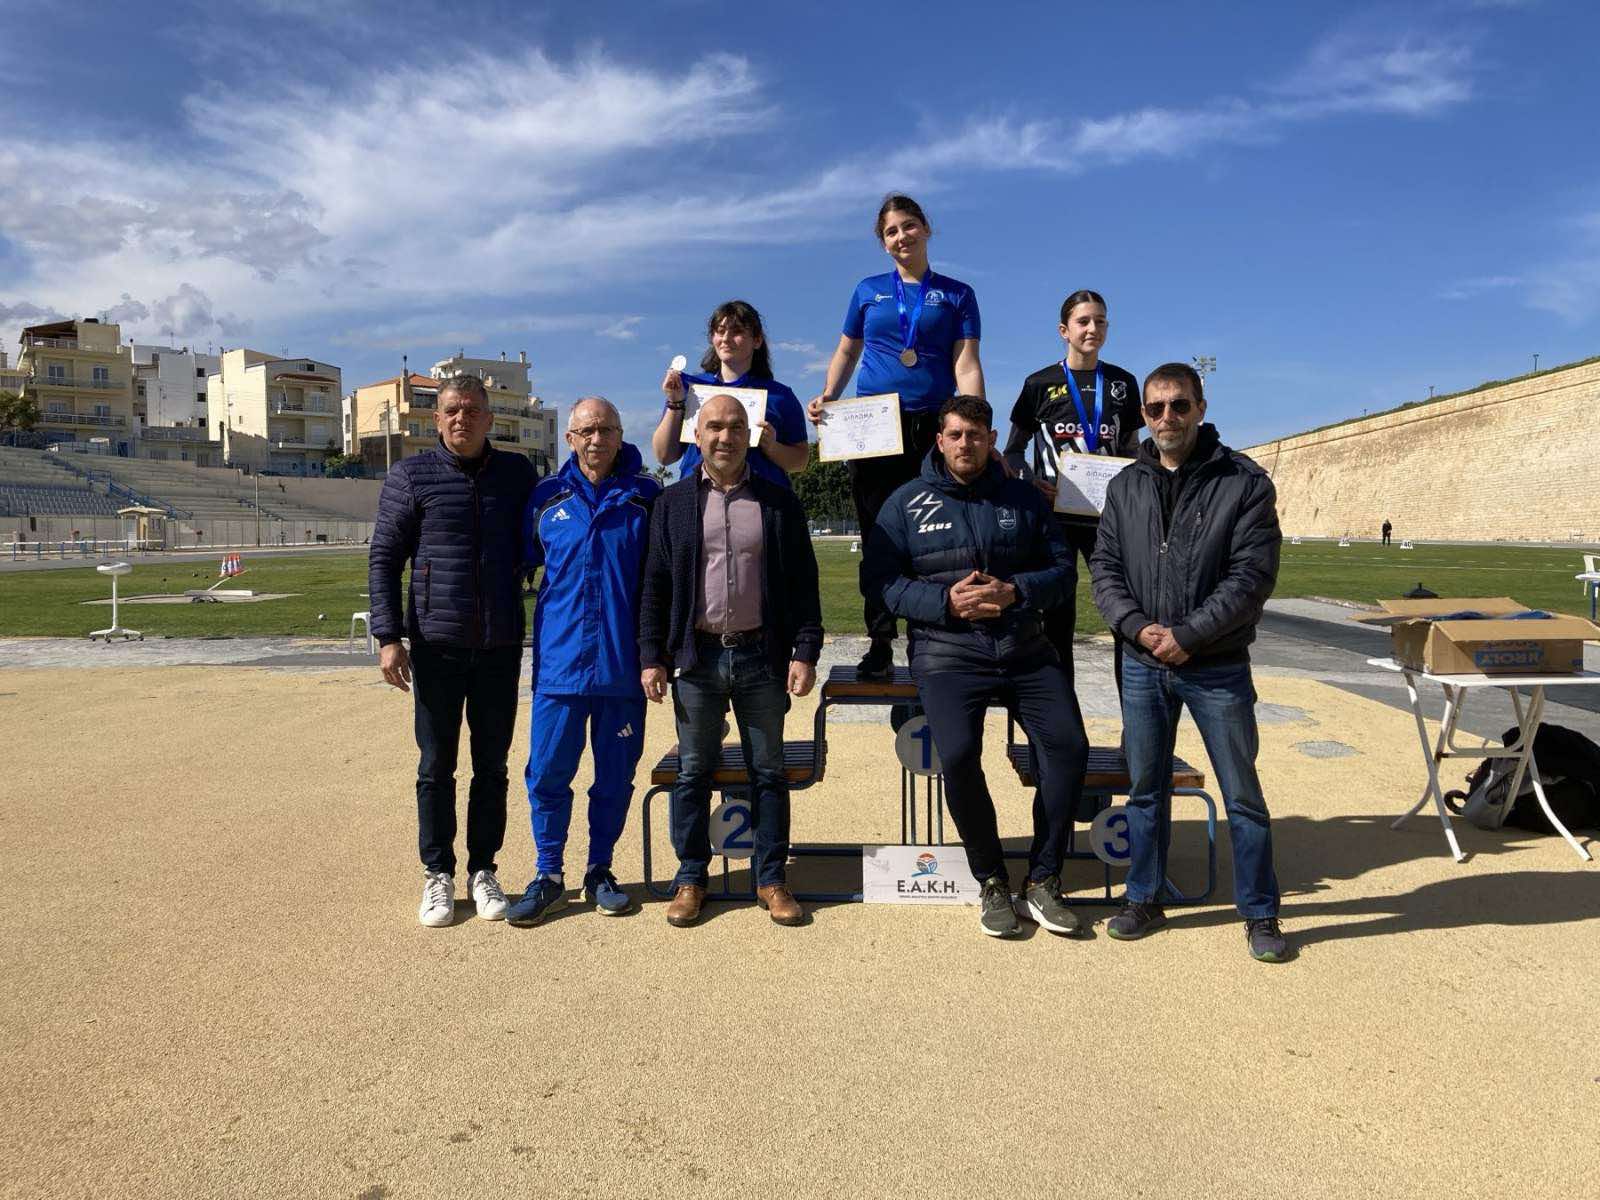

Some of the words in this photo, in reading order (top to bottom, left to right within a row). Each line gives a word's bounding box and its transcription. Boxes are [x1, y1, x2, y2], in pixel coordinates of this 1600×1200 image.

[1054, 423, 1116, 436] COSOS
[910, 725, 931, 769] 1
[723, 805, 754, 849] 2
[1104, 814, 1131, 859] 3
